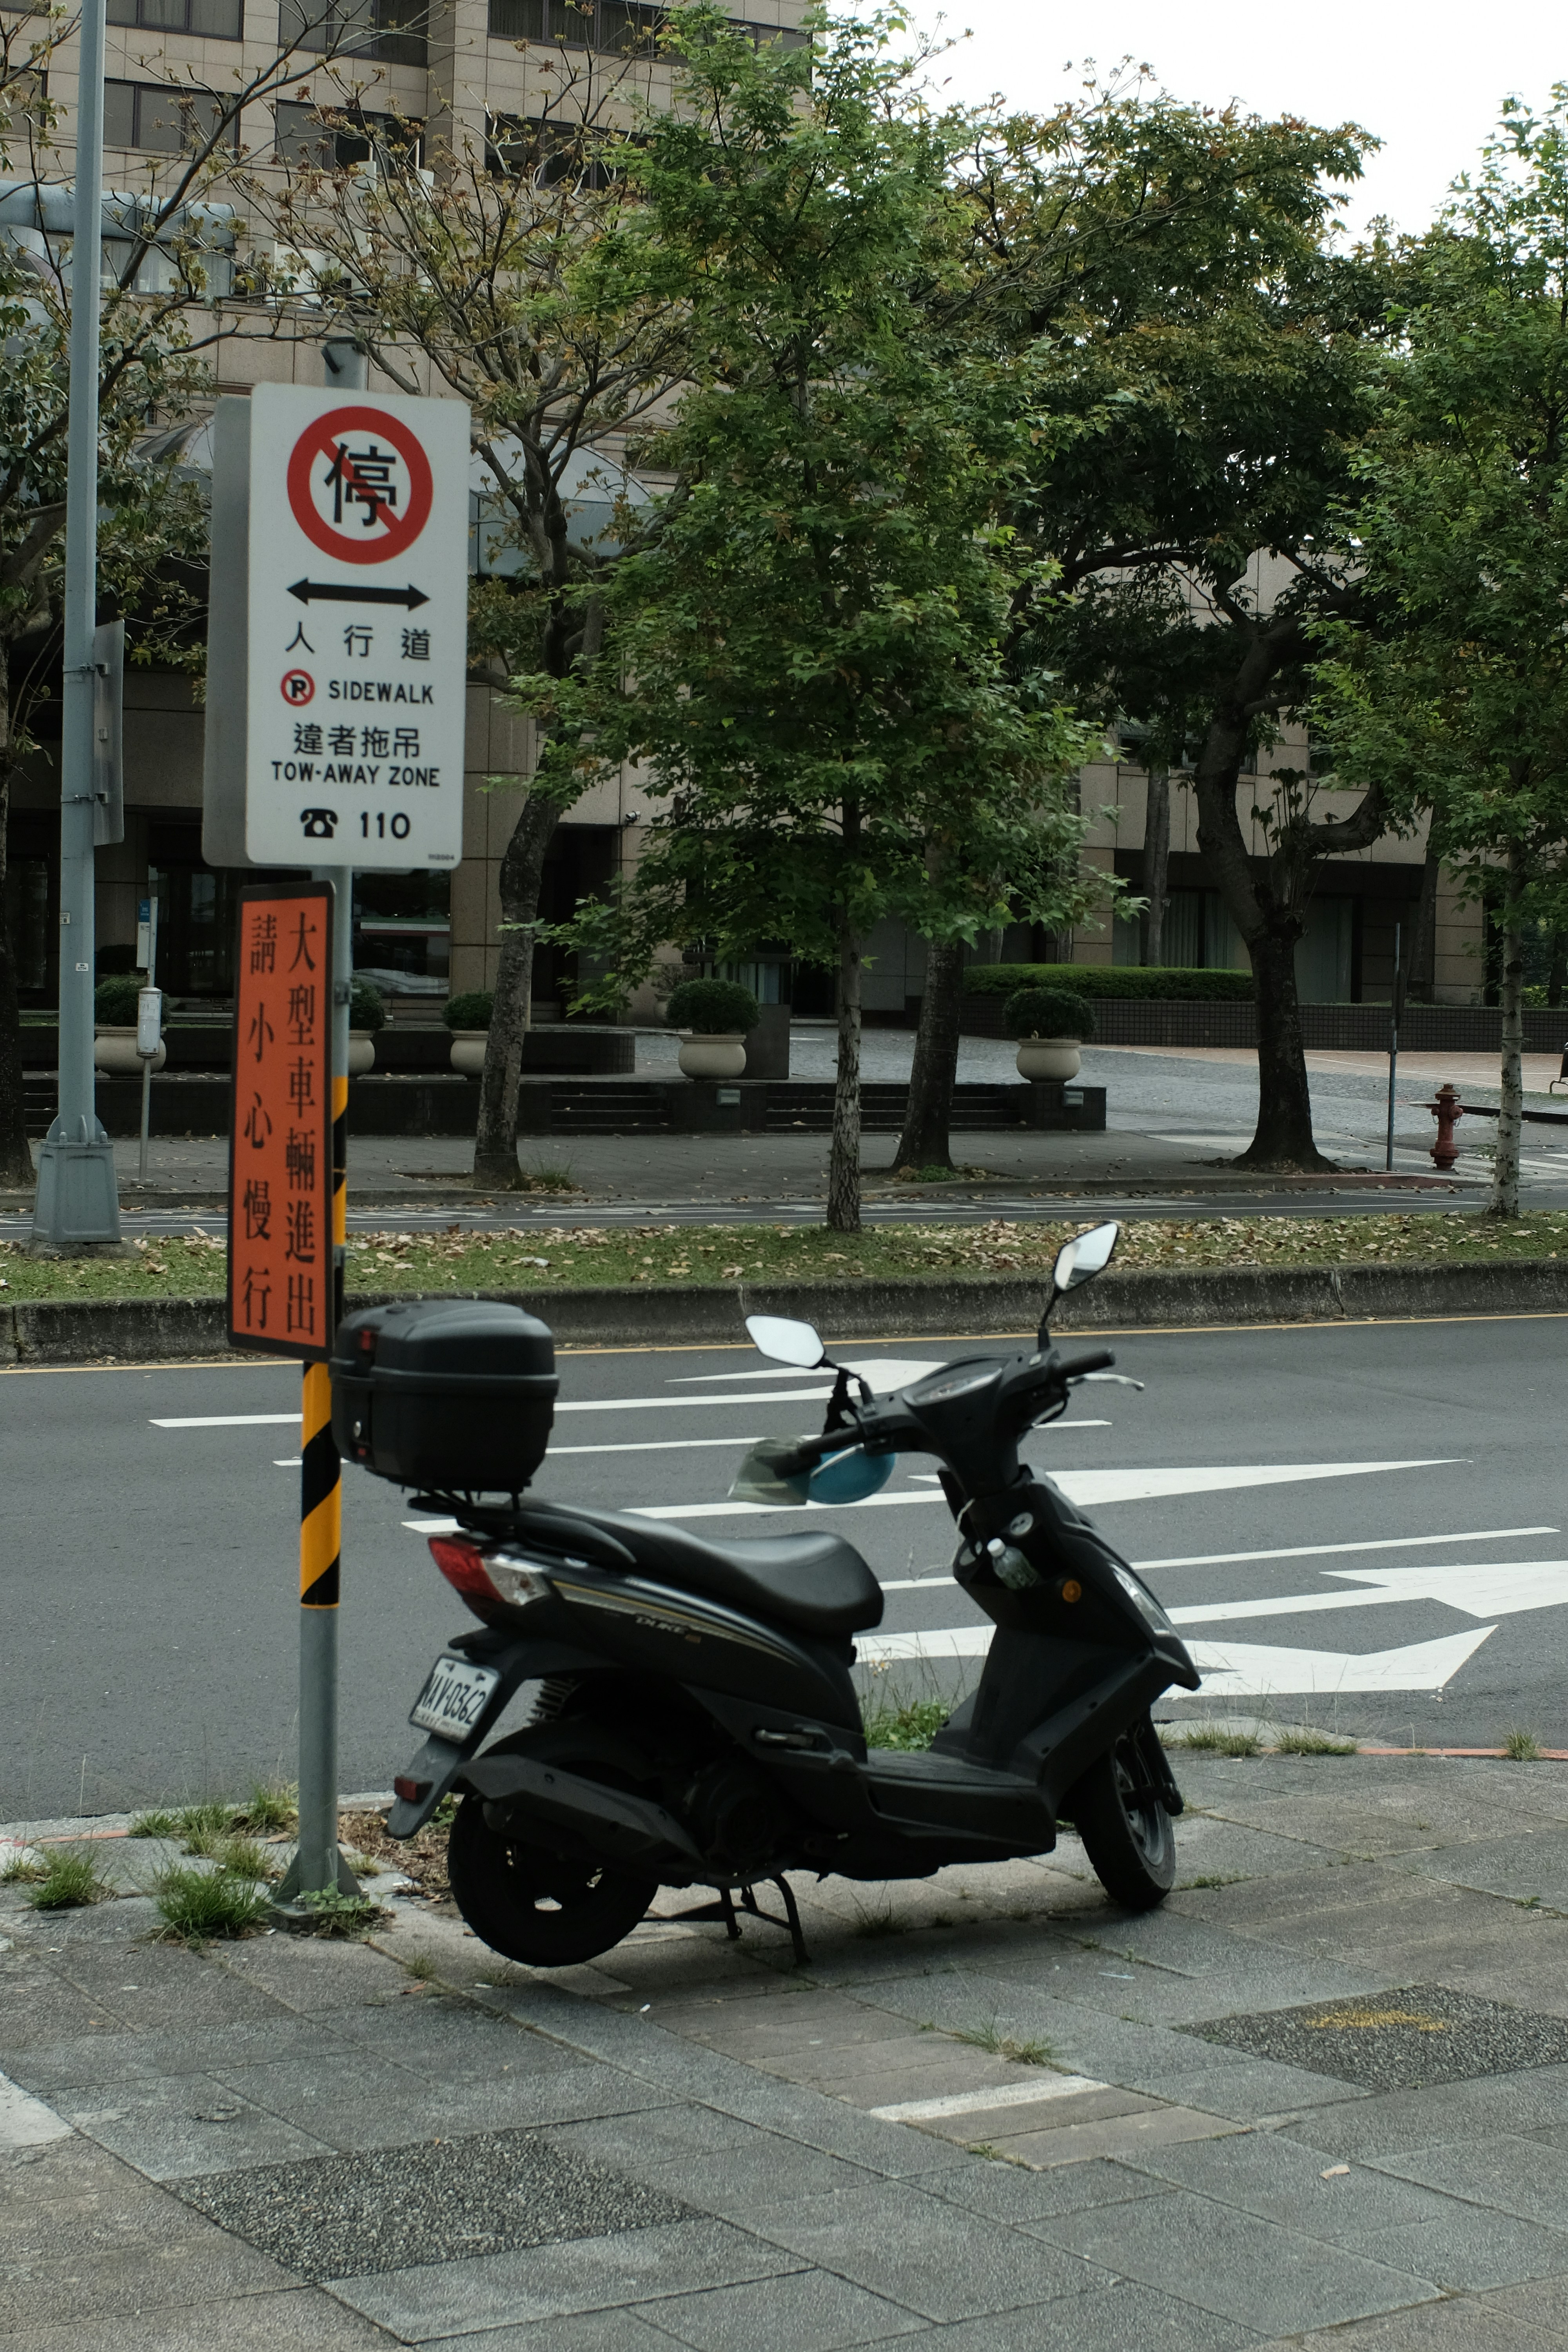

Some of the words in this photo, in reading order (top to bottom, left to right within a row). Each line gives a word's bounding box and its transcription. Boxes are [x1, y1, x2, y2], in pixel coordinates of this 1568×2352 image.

[325, 442, 397, 526] 停
[285, 621, 431, 660] 人行道
[328, 681, 434, 704] SIDEWALK
[293, 722, 420, 759] 違者拖吊
[272, 761, 380, 785] TOW-AWAY
[388, 766, 440, 787] ZONE
[360, 811, 411, 839] 110
[242, 913, 278, 1330] 請小心慢行
[285, 912, 317, 1336] 大型車輛進出
